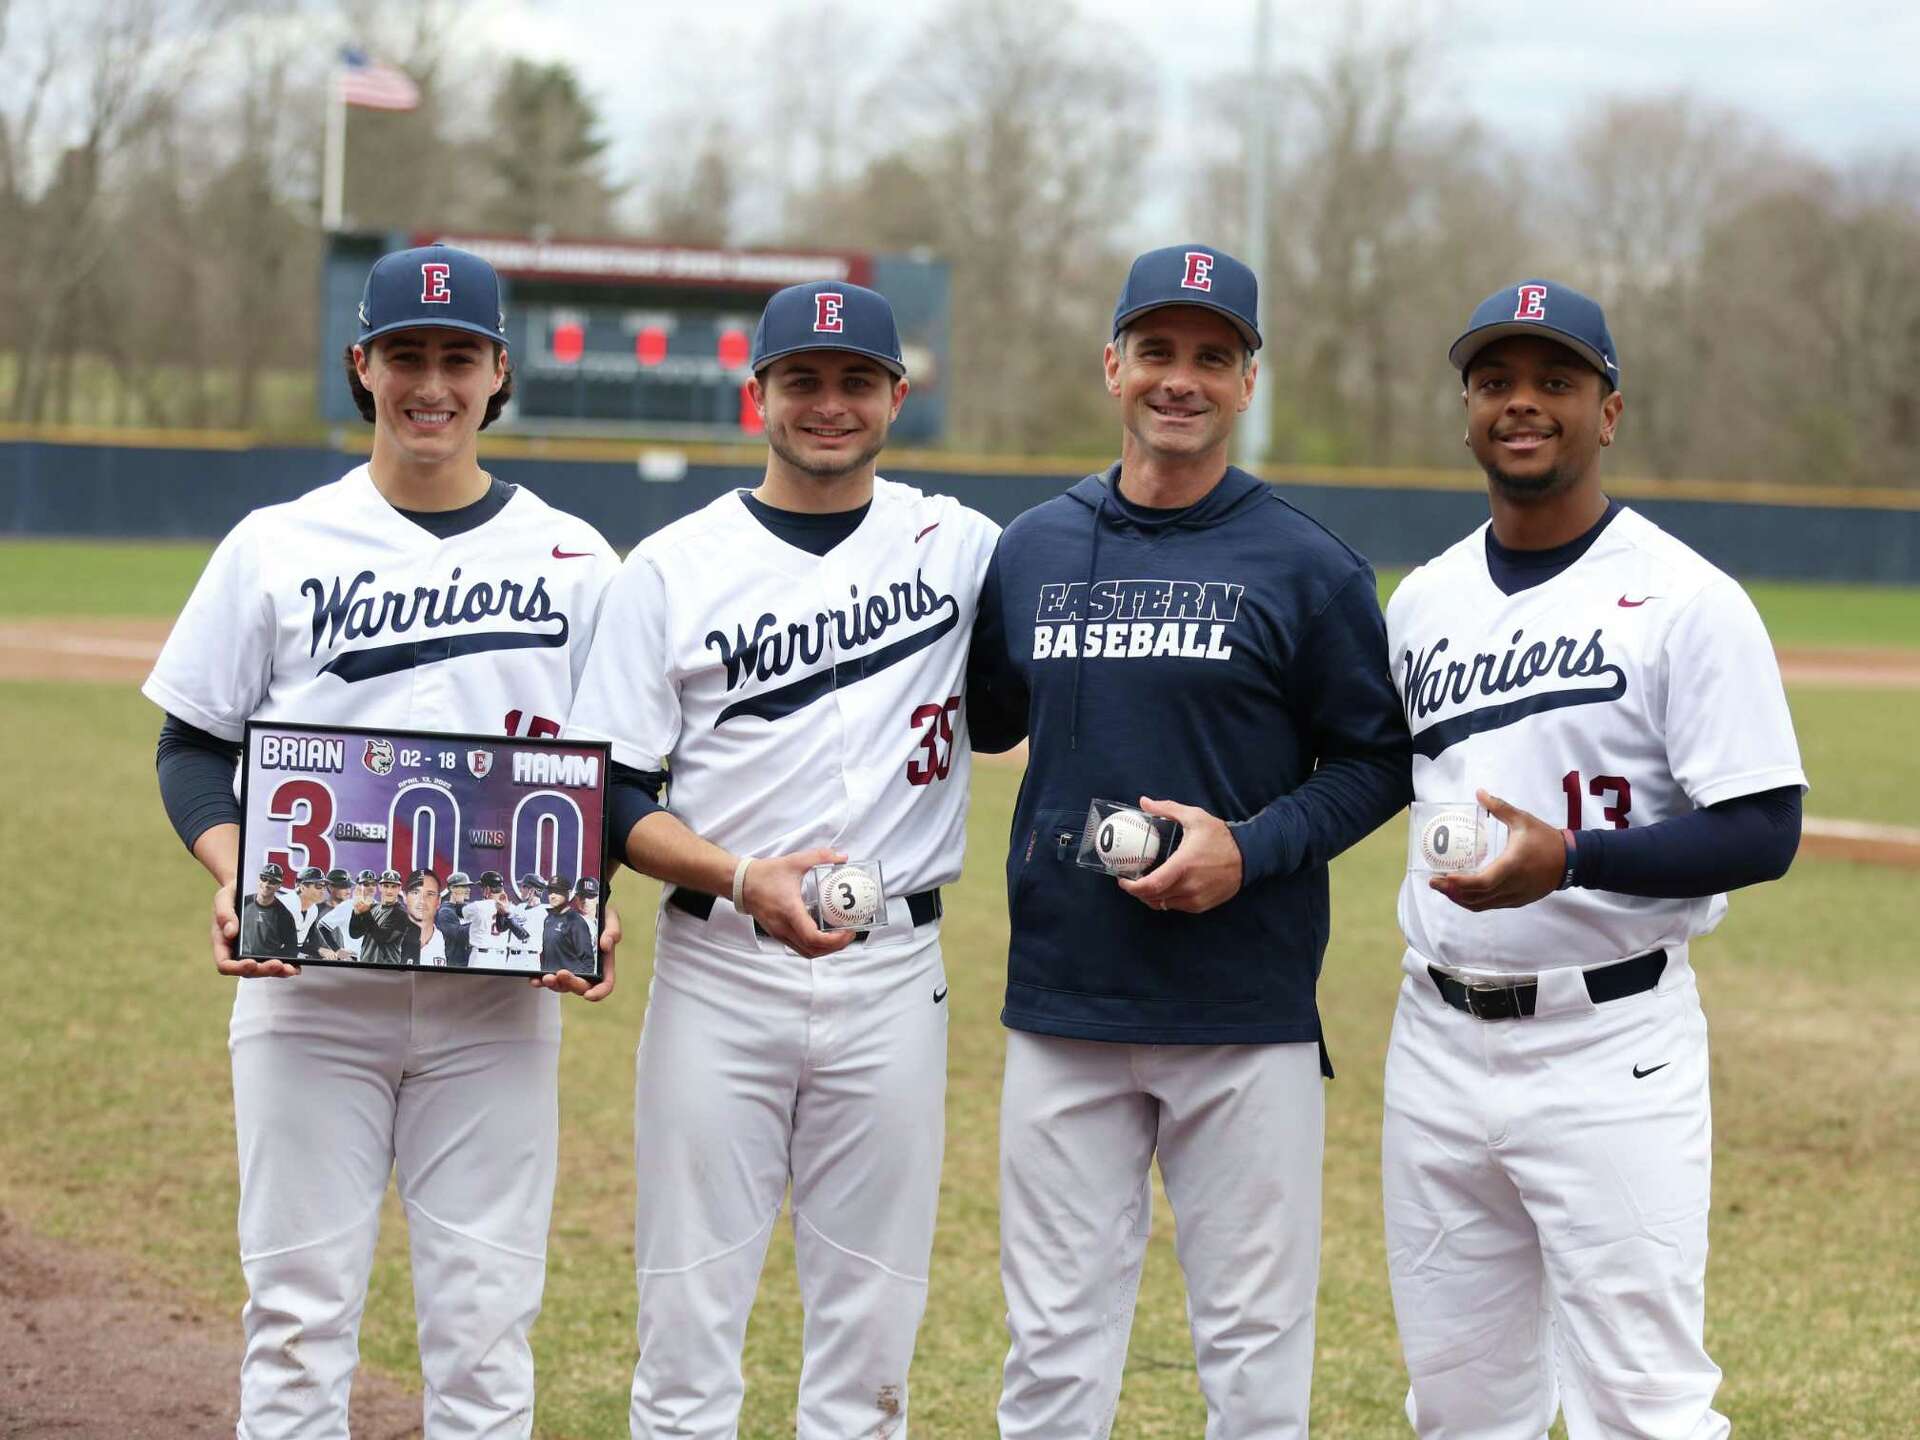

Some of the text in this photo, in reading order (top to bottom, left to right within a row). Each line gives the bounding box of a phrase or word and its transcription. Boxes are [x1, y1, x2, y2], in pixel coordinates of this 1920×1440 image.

[421, 263, 451, 304] E
[1181, 252, 1214, 292] E
[814, 293, 844, 333] E
[1514, 285, 1547, 320] E
[301, 567, 551, 658] Warriors
[1036, 579, 1244, 622] EASTERN
[705, 568, 943, 695] Warriors
[1033, 623, 1232, 660] BASEBALL
[1402, 628, 1605, 723] Warriors
[261, 736, 344, 773] BRIAN
[400, 749, 421, 767] 02
[438, 751, 456, 769] 18
[906, 696, 960, 786] 35
[512, 752, 599, 788] HAMM
[1562, 770, 1631, 831] 13
[266, 775, 337, 893] 3
[335, 822, 506, 849] CAREER WINS
[1100, 823, 1114, 853] 0
[1433, 825, 1449, 854] 0
[838, 882, 856, 911] 3
